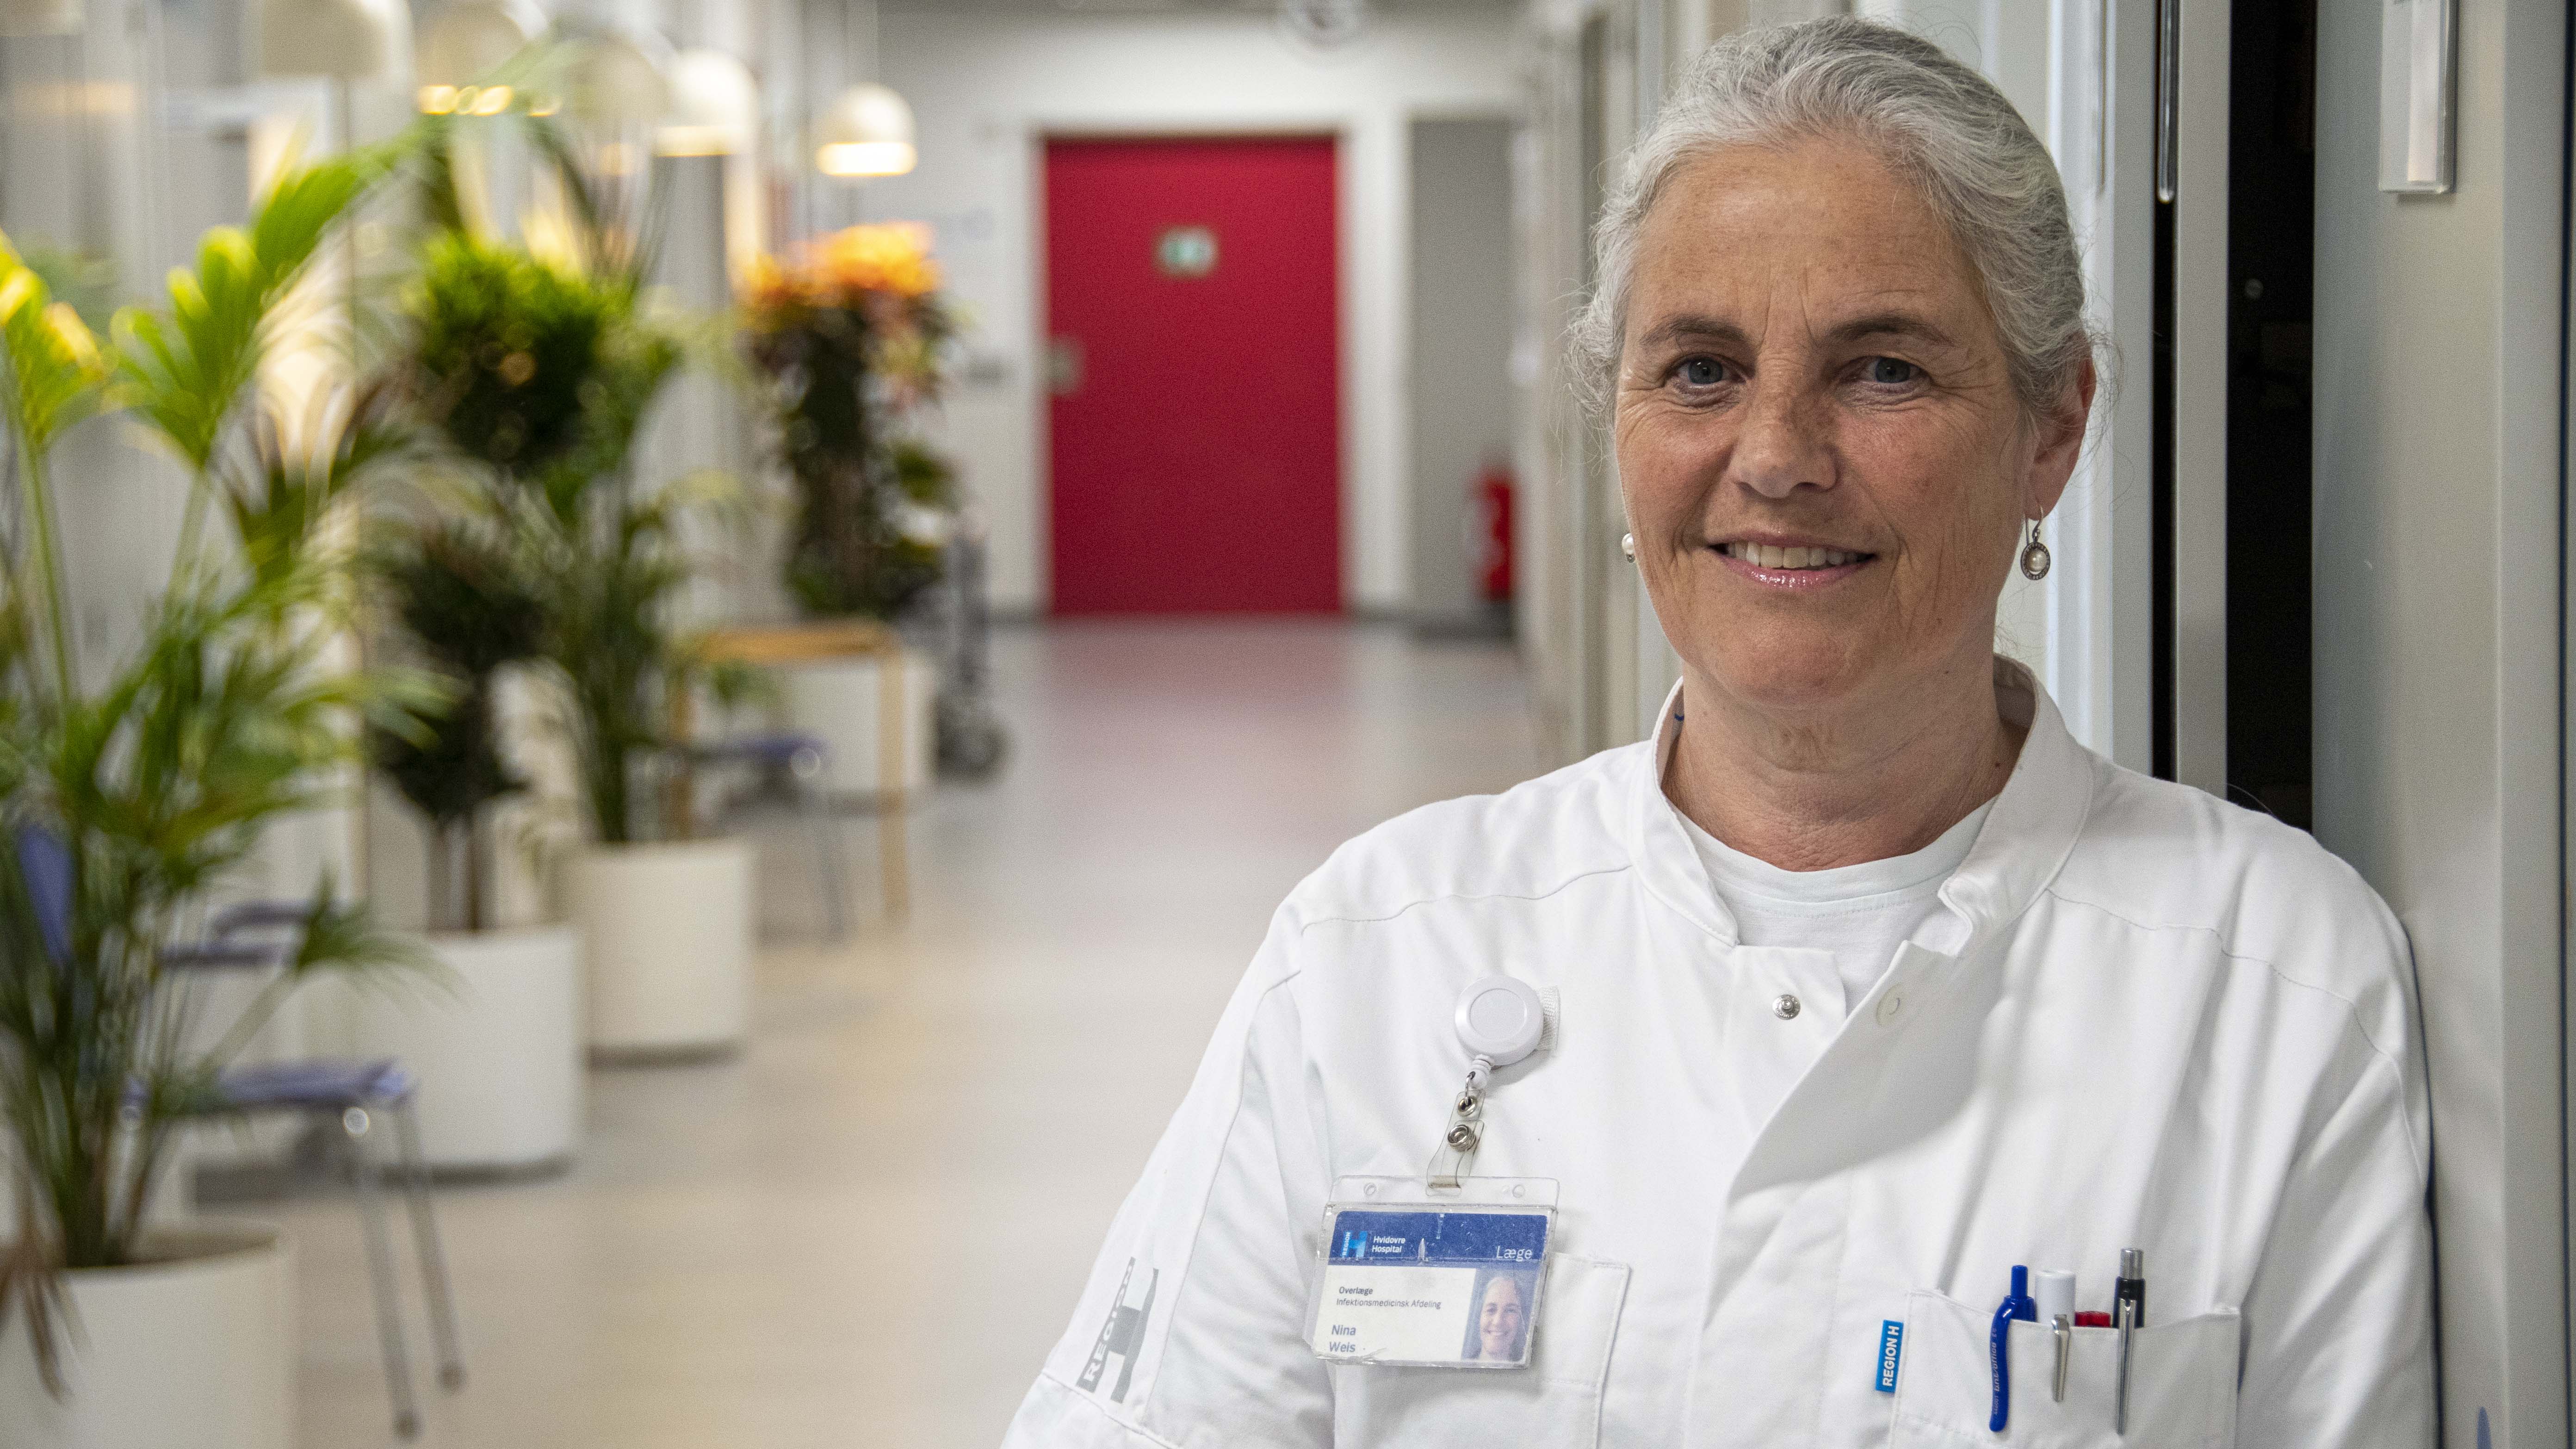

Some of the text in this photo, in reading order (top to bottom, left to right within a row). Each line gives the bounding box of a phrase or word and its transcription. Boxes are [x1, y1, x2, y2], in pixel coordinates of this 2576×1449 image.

[1342, 1232, 1351, 1257] REGION
[1373, 1236, 1406, 1244] Hvidovre
[1371, 1245, 1402, 1254] Hospital
[1496, 1246, 1533, 1262] Læge
[1338, 1286, 1374, 1296] Overlæge
[1336, 1298, 1441, 1309] Infektionsmedicinsk Afdeling
[1331, 1325, 1356, 1336] Nina
[1329, 1342, 1356, 1353] Weis
[1882, 1325, 1900, 1387] REGION H
